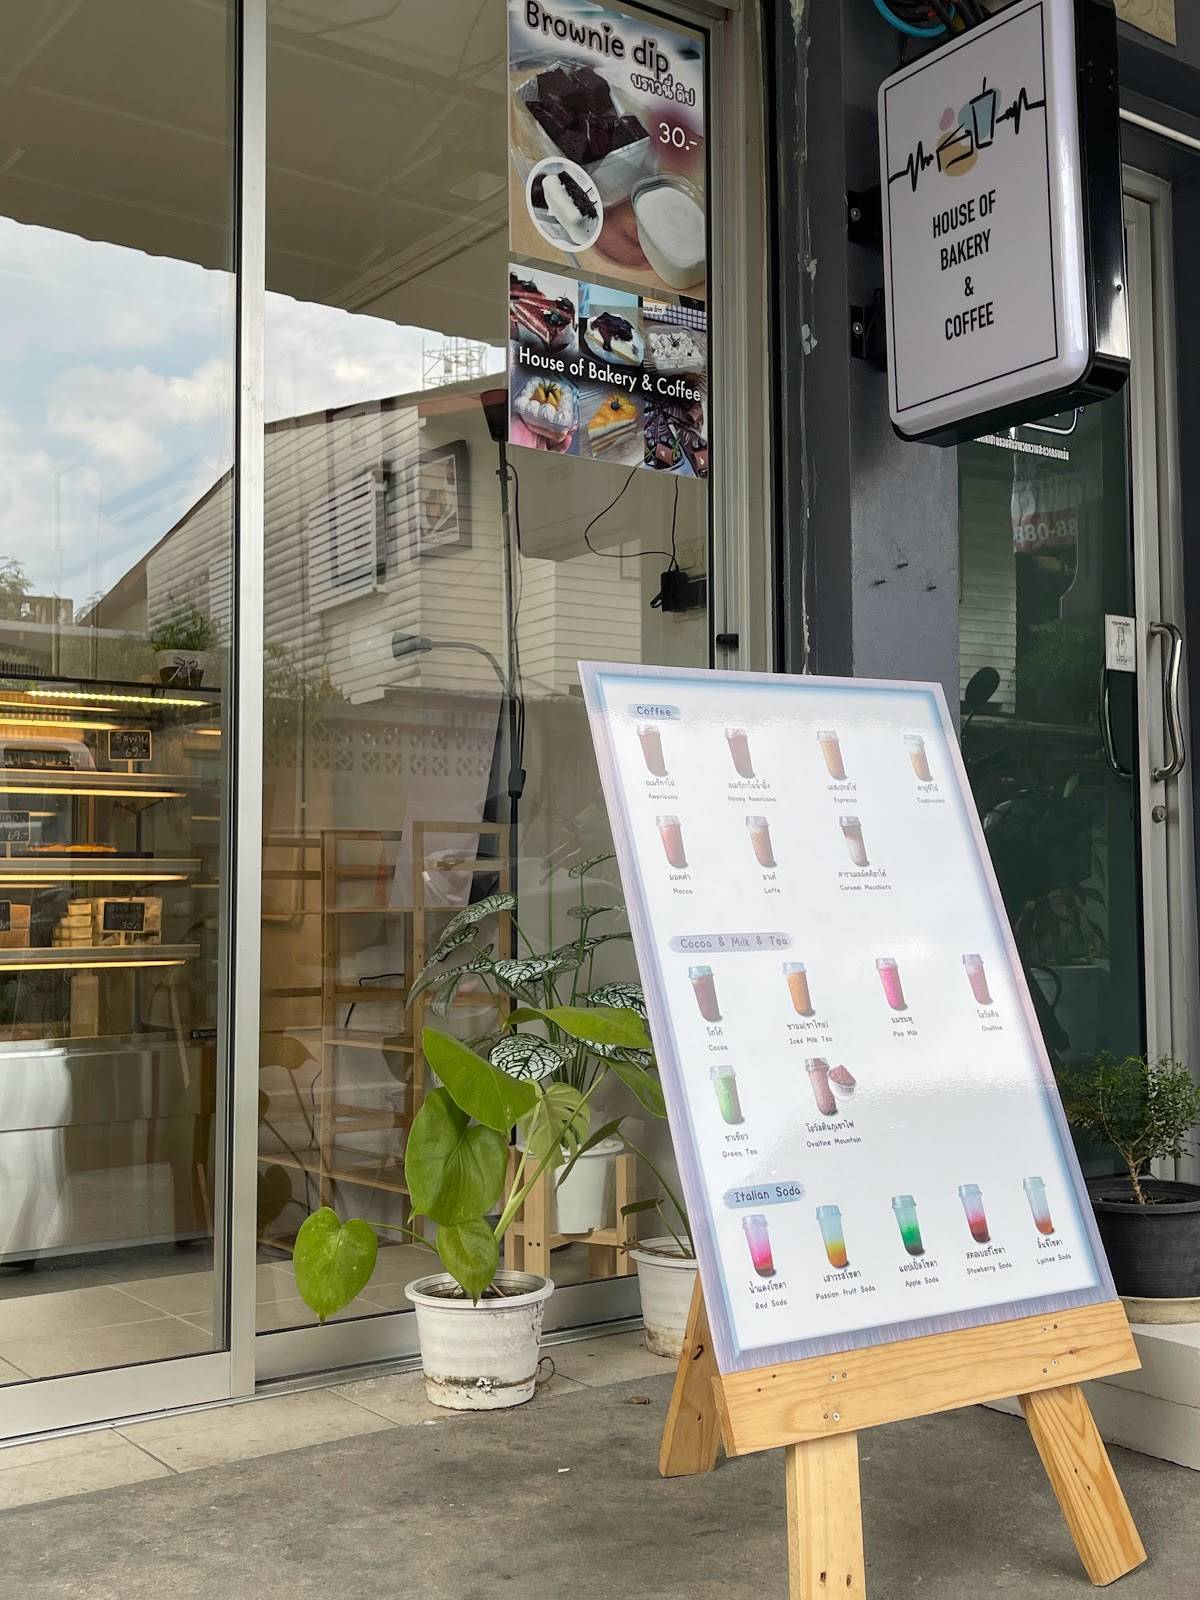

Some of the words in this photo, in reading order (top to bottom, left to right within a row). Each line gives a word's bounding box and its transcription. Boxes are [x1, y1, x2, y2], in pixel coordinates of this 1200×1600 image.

[526, 0, 624, 58] Brownie
[633, 37, 670, 78] dip
[631, 73, 674, 100] บราวนี่
[676, 82, 695, 106] ดิป
[659, 122, 698, 151] 30.-
[933, 199, 976, 238] HOUSE
[979, 189, 997, 218] OF
[940, 229, 990, 271] BAKERY
[964, 276, 974, 297] &
[944, 302, 994, 341] COFFEE
[519, 346, 564, 372] House
[569, 358, 584, 376] of
[589, 364, 637, 392] Bakery
[641, 375, 652, 391] &
[657, 378, 701, 401] Coffee
[637, 705, 672, 717] Coffee
[834, 796, 858, 804] Espresso
[672, 887, 693, 895] Mocca
[680, 938, 712, 949] Cocoa
[718, 937, 725, 947] &
[731, 936, 750, 947] Milk
[756, 935, 762, 946] &
[769, 935, 788, 946] Tea
[789, 1037, 804, 1045] Iced
[724, 1131, 749, 1142] ชาเขียว
[806, 1140, 831, 1148] Ovaltine
[834, 1136, 862, 1145] Mountain
[722, 1150, 743, 1158] Green
[745, 1148, 758, 1156] Tea
[734, 1190, 770, 1203] Italian
[775, 1186, 801, 1198] Soda
[998, 1261, 1013, 1270] Soda
[1036, 1256, 1056, 1266] Lychee
[1057, 1253, 1072, 1261] Soda
[823, 1268, 862, 1283] เสาวรสโซดา
[905, 1279, 922, 1288] Apple
[924, 1276, 940, 1285] Soda
[749, 1280, 787, 1294] น้ำแดงโซดา
[815, 1291, 840, 1301] Passion
[843, 1287, 857, 1296] fruit
[860, 1284, 876, 1293] Soda
[755, 1301, 768, 1310] Red
[771, 1299, 788, 1308] Soda
